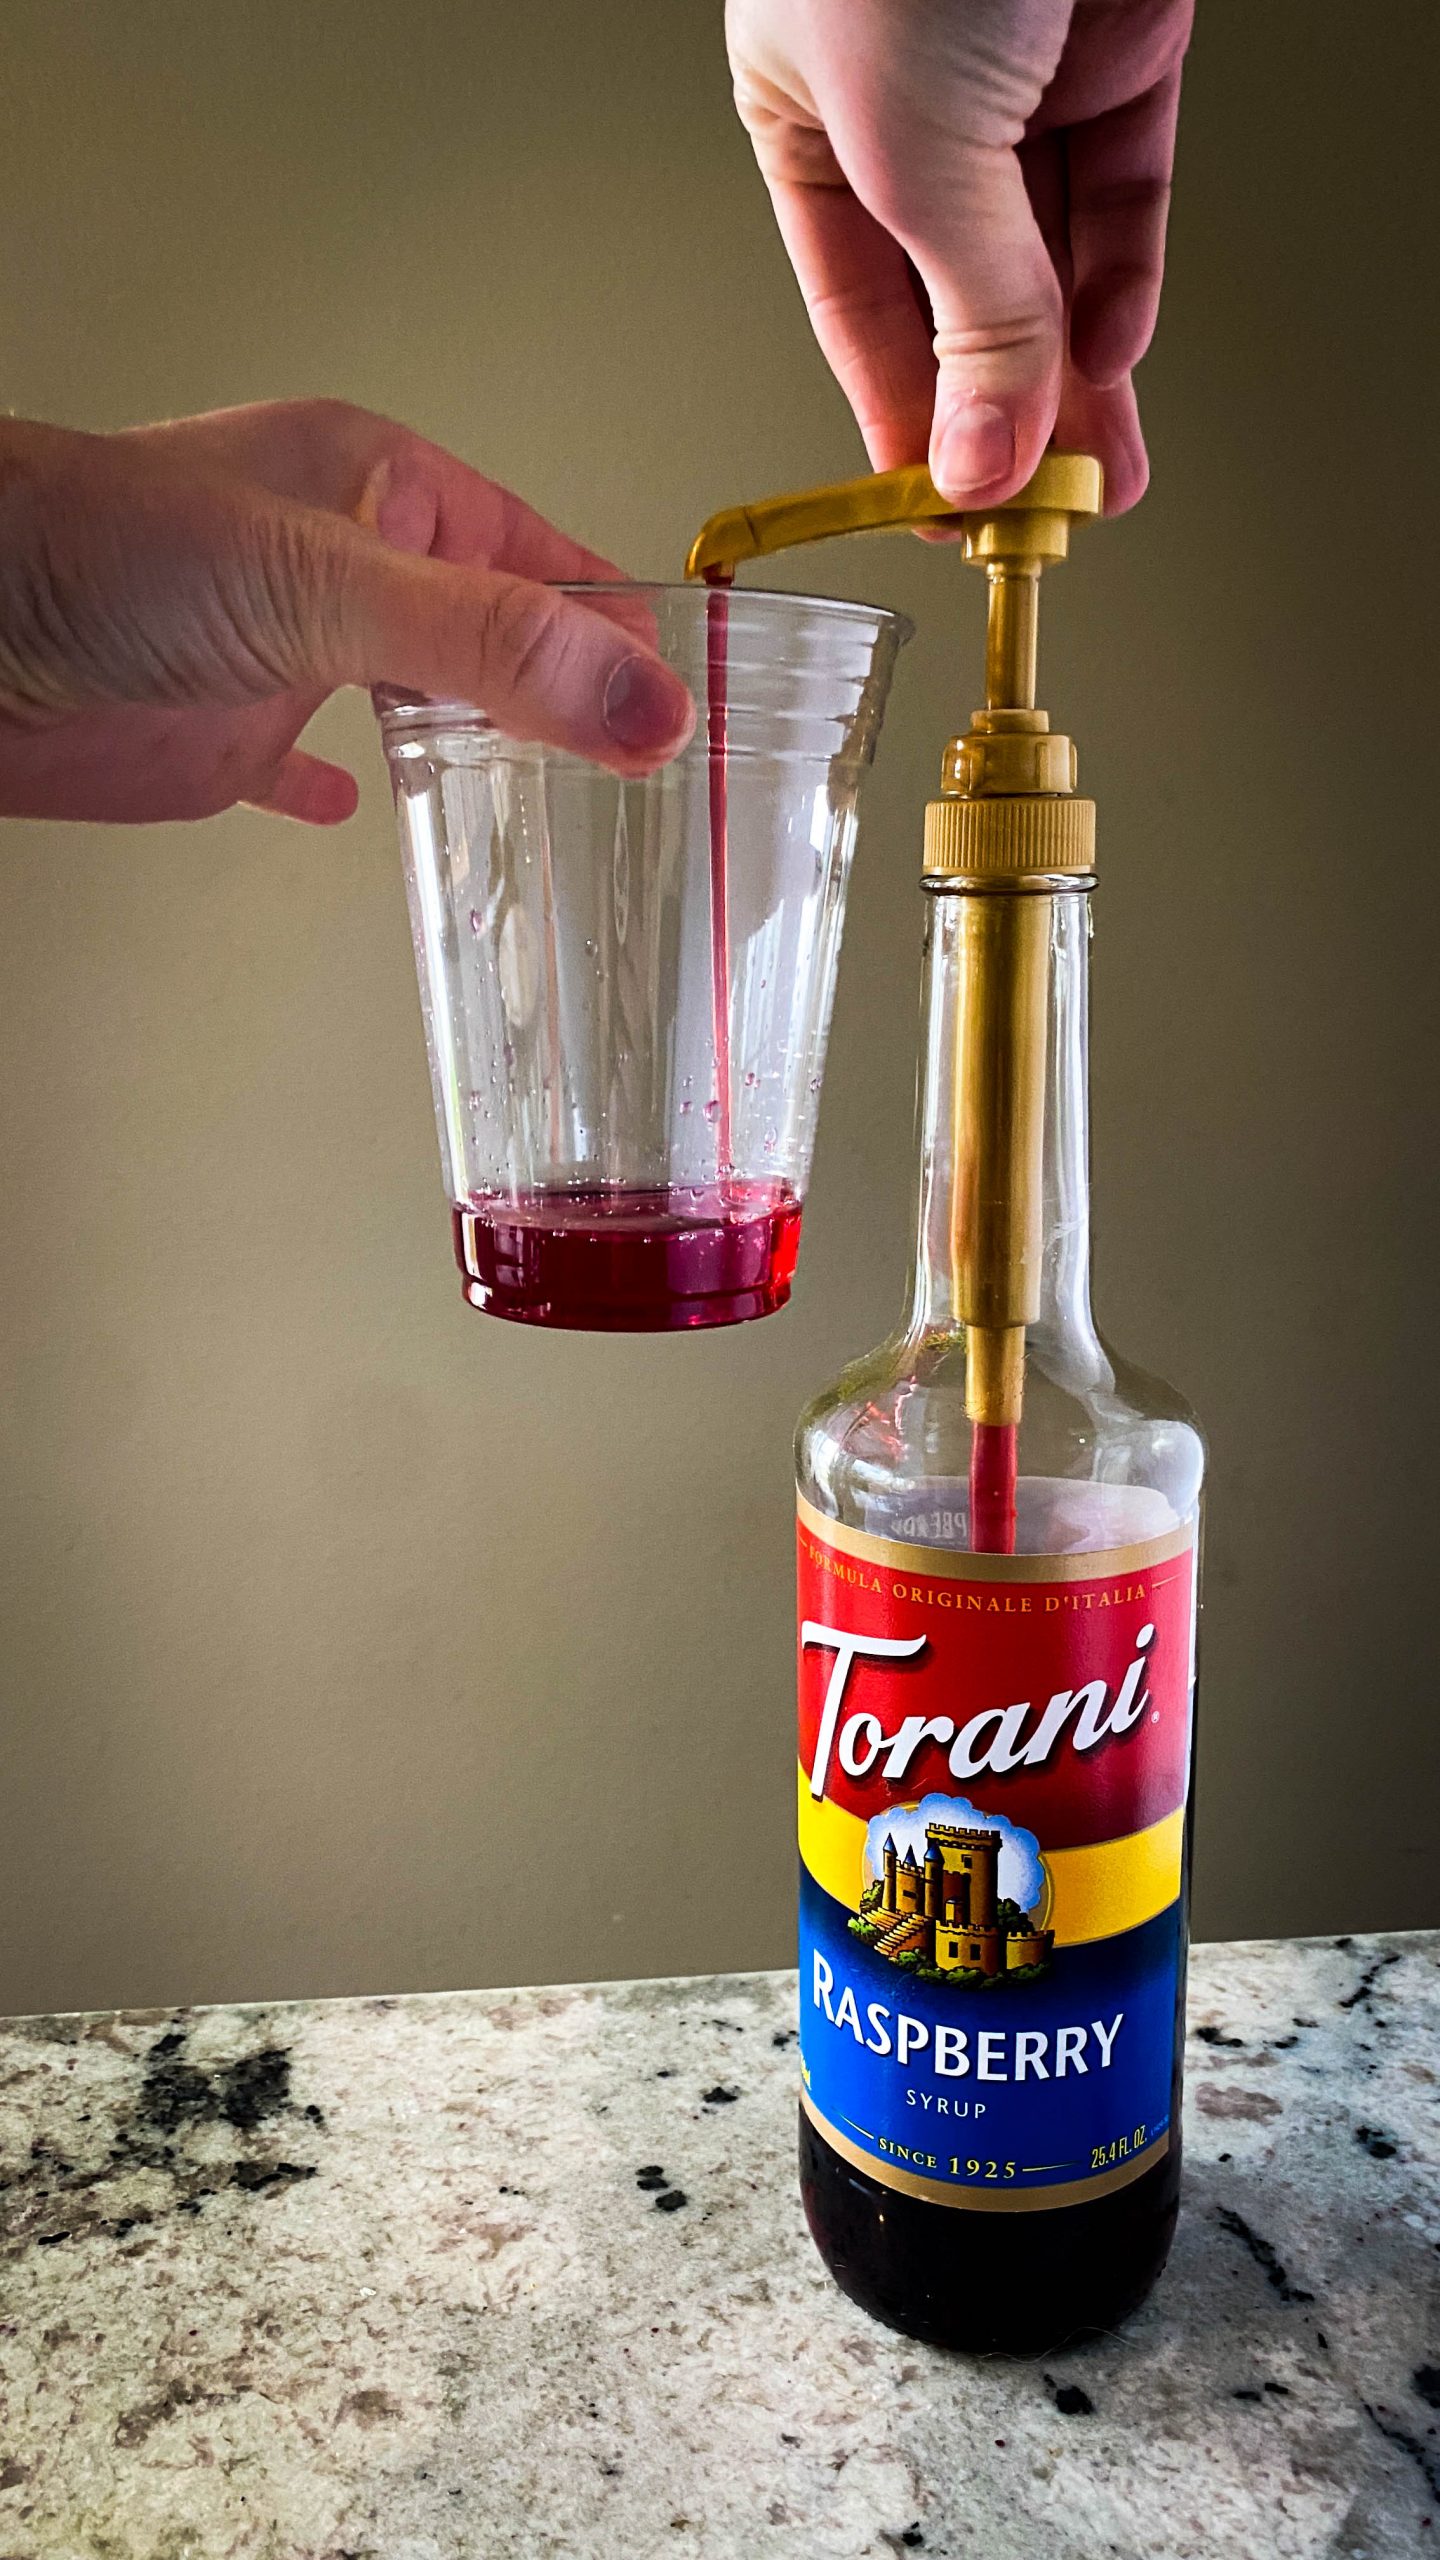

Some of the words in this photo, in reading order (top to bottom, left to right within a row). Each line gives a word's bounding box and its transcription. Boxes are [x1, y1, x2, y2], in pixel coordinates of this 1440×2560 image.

[809, 1545, 883, 1594] FORMULA
[892, 1583, 1032, 1613] ORIGINALE
[1044, 1583, 1146, 1613] D'ITALIA
[801, 1620, 1155, 1798] Torani
[812, 1948, 1125, 2082] RASPBERRY
[906, 2089, 986, 2119] SYRUP
[878, 2137, 938, 2169] SINCE
[949, 2157, 1016, 2179] 1925
[1091, 2141, 1116, 2169] 25.4
[1118, 2136, 1133, 2158] FL.
[1133, 2124, 1148, 2149] OZ.
